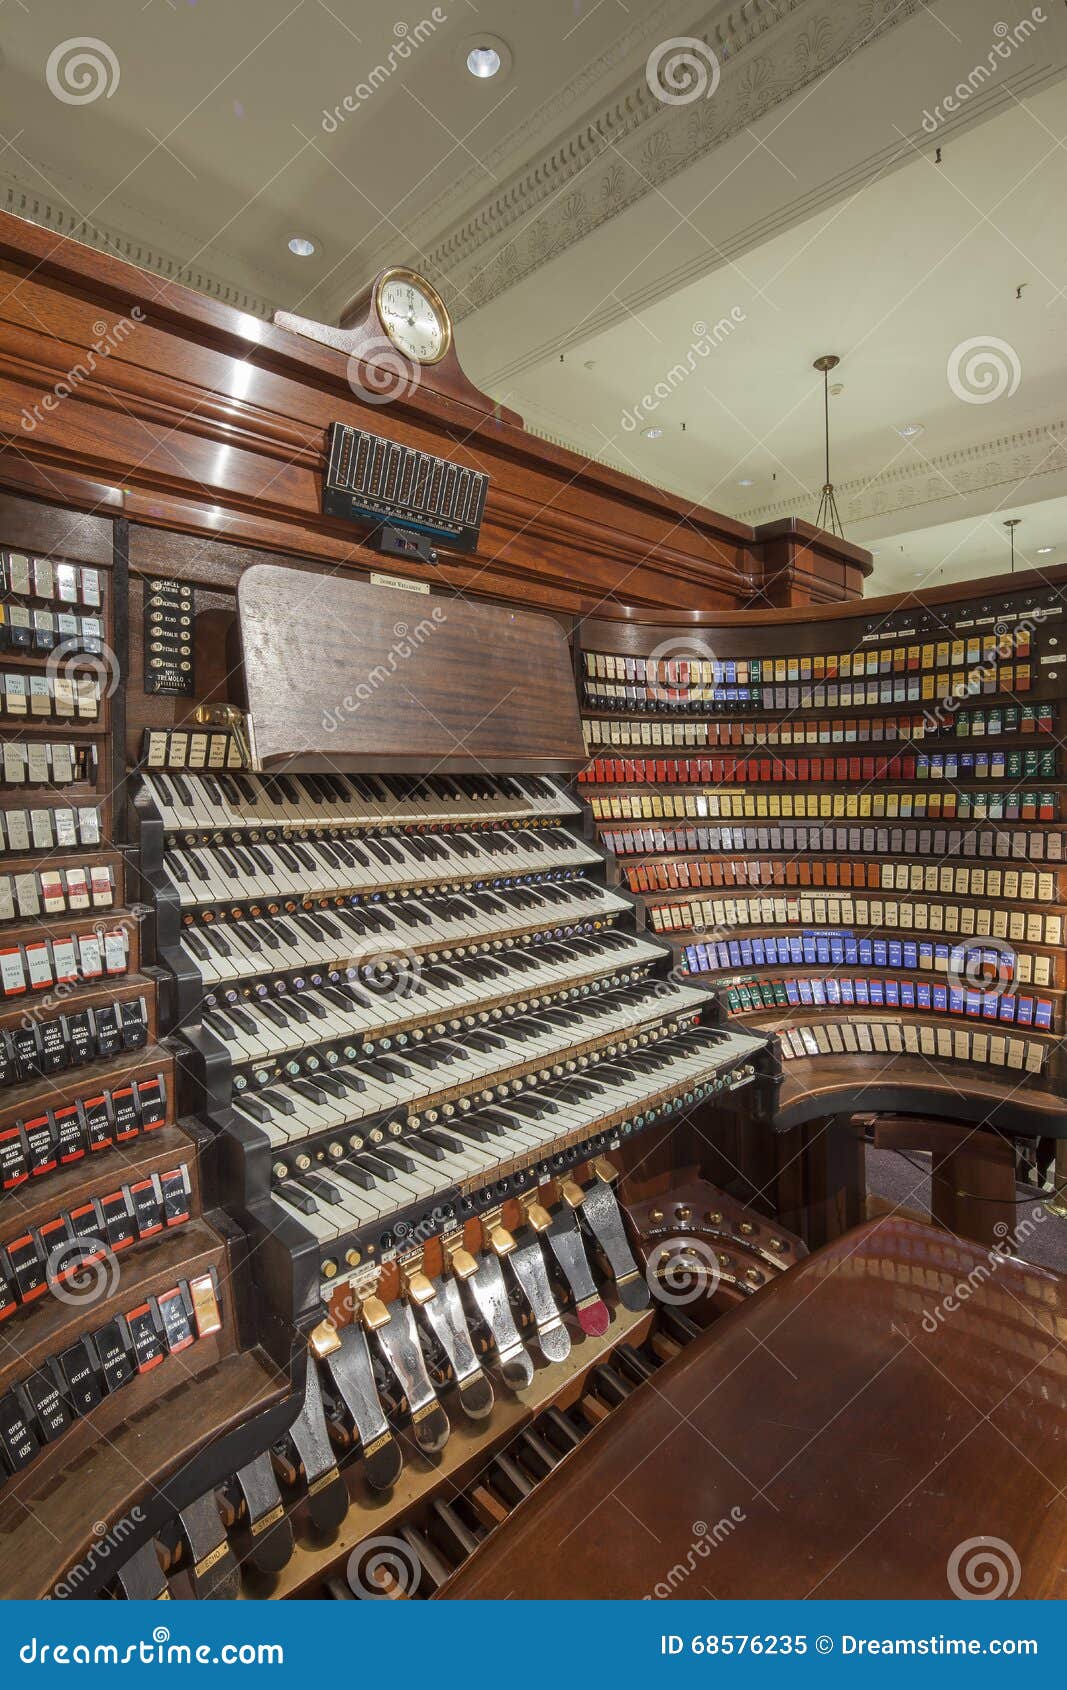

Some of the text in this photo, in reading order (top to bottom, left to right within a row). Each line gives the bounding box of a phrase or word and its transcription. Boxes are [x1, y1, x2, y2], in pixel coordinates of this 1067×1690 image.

[44, 1032, 62, 1041] DOUBLE
[60, 1131, 81, 1143] FAGOTTO
[139, 1330, 149, 1339] VOX
[104, 1352, 127, 1370] DIAPASON
[106, 1347, 120, 1359] OPEN
[71, 1367, 90, 1384] OCTAVE
[37, 1390, 60, 1410] STOPPED
[42, 1399, 60, 1416] QUINT
[8, 1420, 23, 1435] OPEN
[10, 1427, 28, 1445] QUINT
[205, 1551, 222, 1569] ECHO
